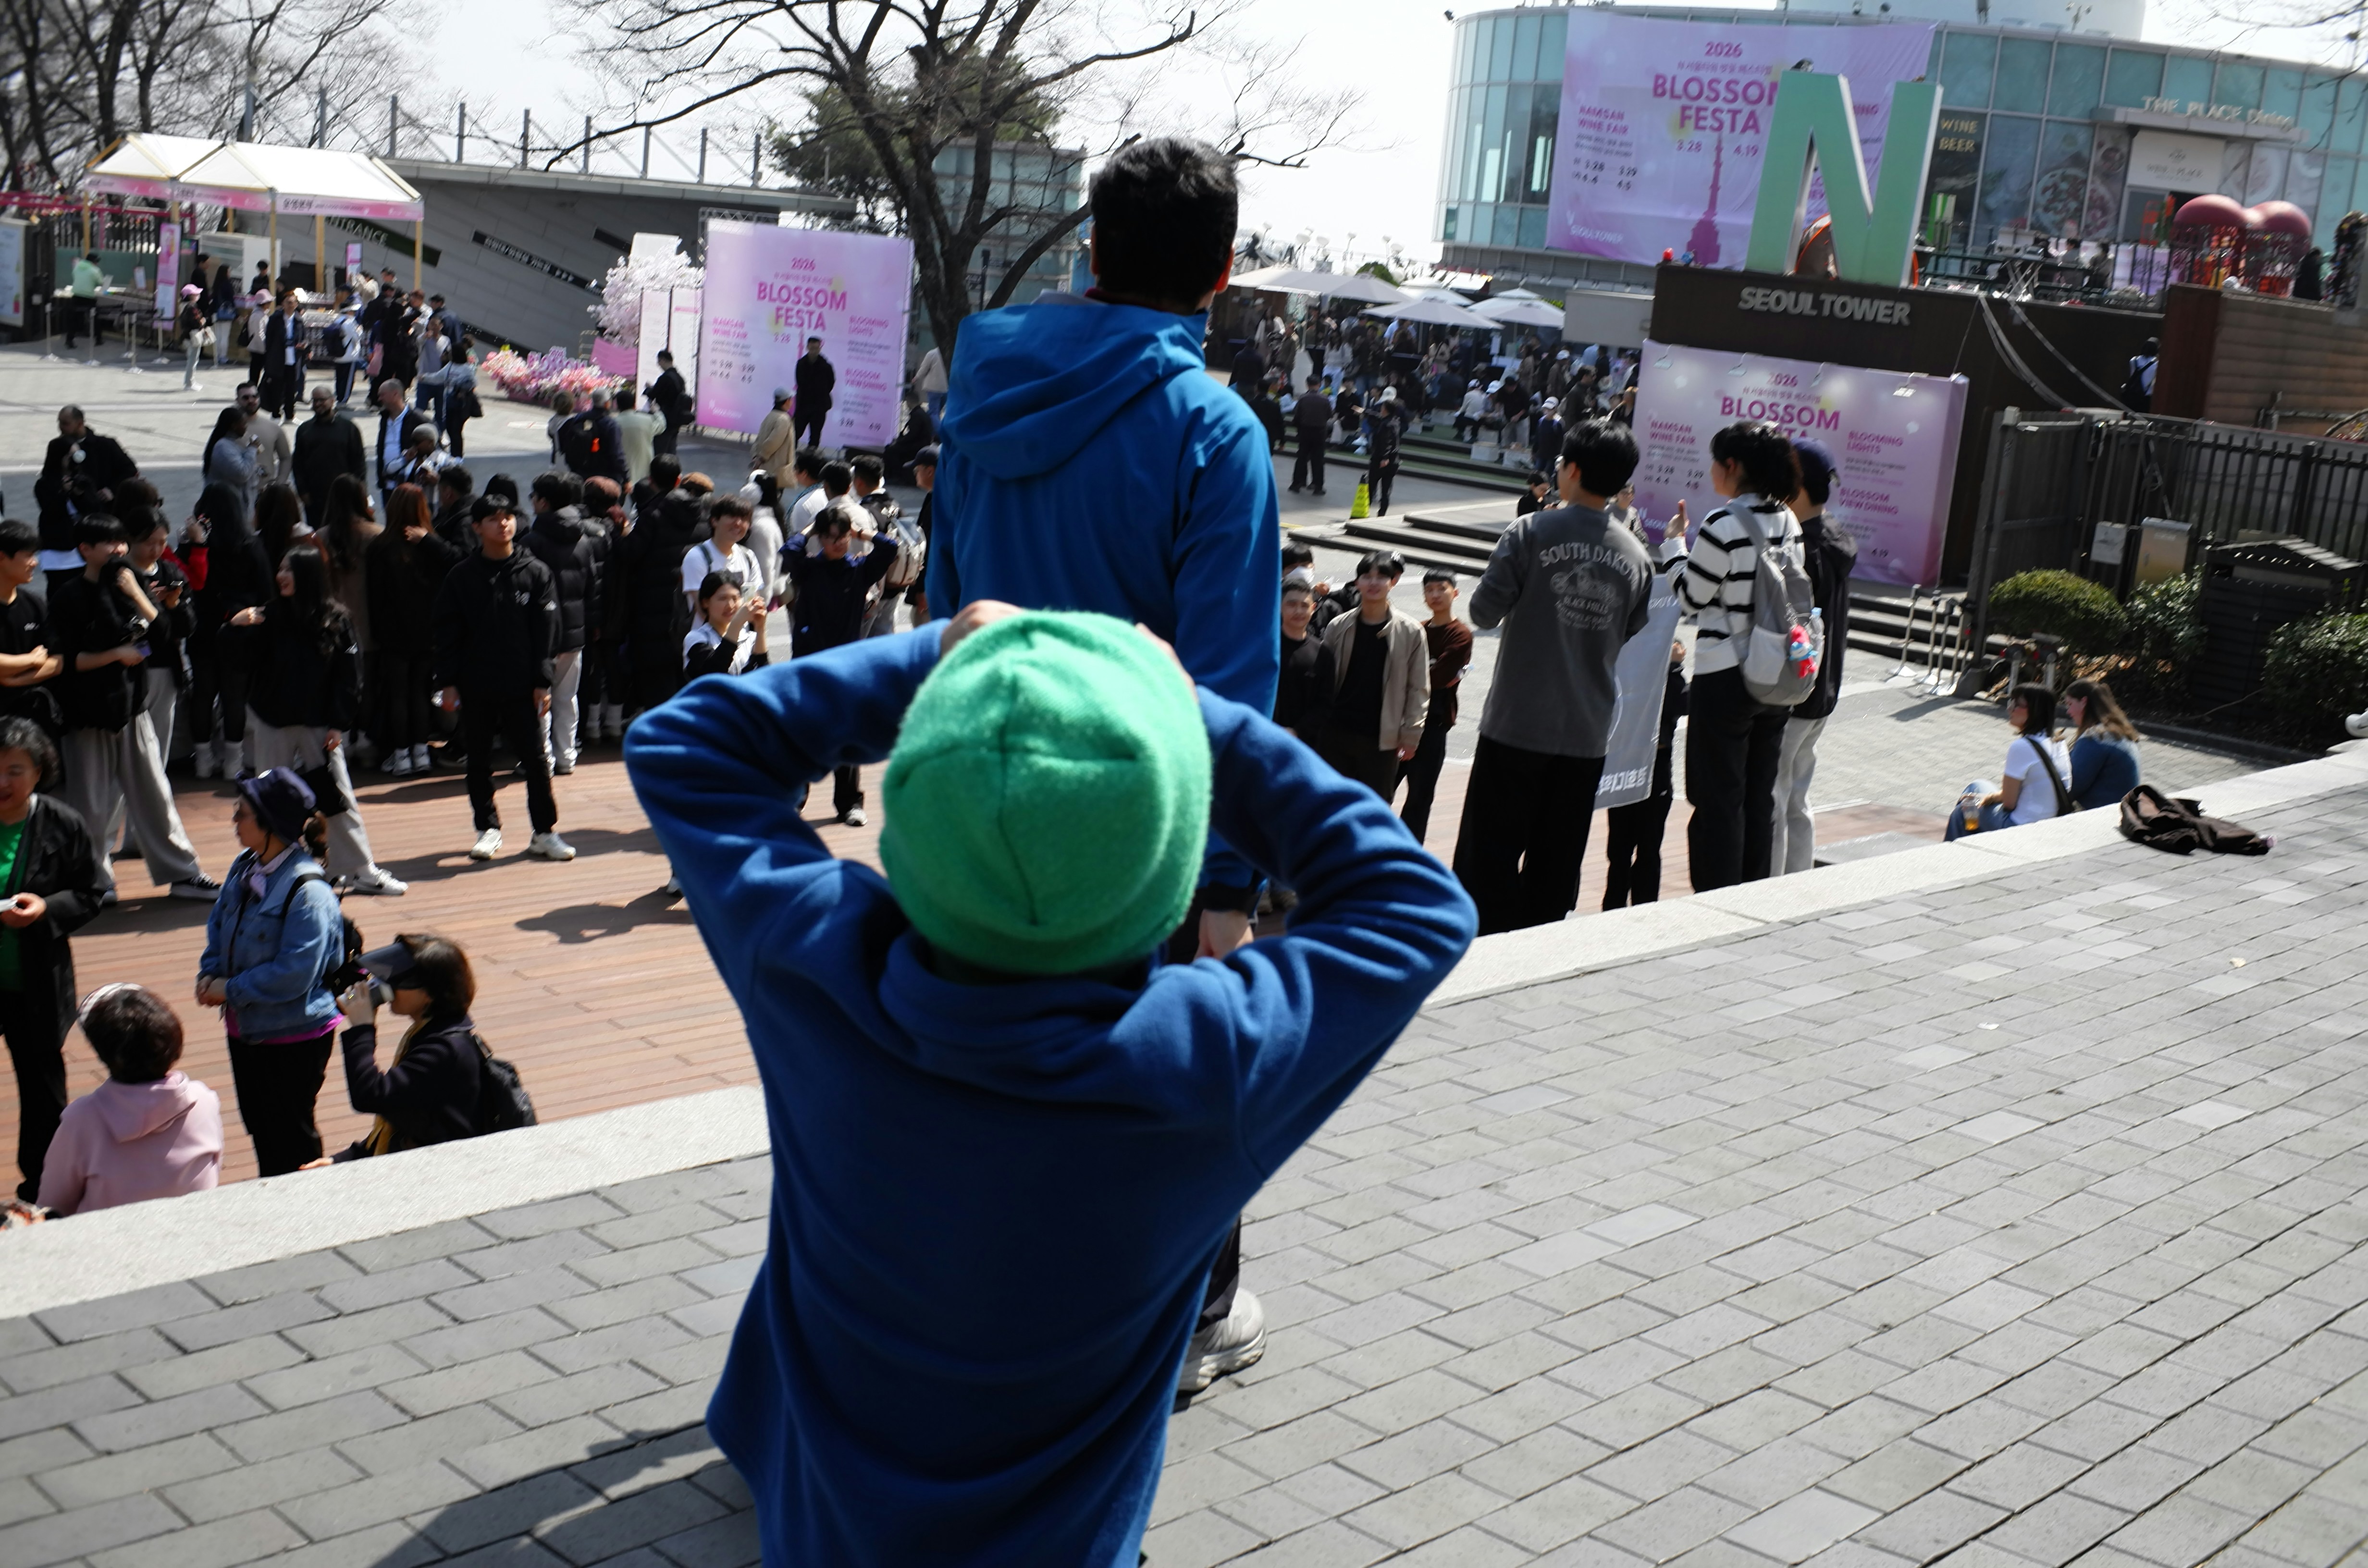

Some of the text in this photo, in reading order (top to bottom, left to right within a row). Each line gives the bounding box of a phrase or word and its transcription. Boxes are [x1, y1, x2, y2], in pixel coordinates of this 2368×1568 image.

[1705, 41, 1743, 58] 2026
[1579, 105, 1625, 121] NAMSAN
[2141, 96, 2180, 113] THE
[2185, 101, 2243, 121] PLACE
[1578, 117, 1629, 136] WINE FAIR
[1679, 104, 1761, 135] FESTA
[1941, 118, 1978, 134] WINE
[1676, 138, 1759, 158] 3.28 4.19
[1939, 137, 1975, 152] BEER
[1585, 159, 1605, 172] 3.28
[1745, 70, 1944, 288] N
[791, 257, 816, 271] 2026
[757, 281, 847, 311] BLOSSOM
[1738, 286, 1911, 326] SEOUL TOWER
[775, 306, 826, 331] FESTA
[1767, 372, 1799, 387] 2026
[1720, 396, 1841, 431] BLOSSOM
[1650, 420, 1692, 434] NAMSAN
[1650, 431, 1696, 445] WINE FAIR
[1848, 430, 1904, 447] BLOOMING
[1847, 441, 1881, 454] LIGHTS
[1839, 487, 1890, 503] BLOSSOM
[1539, 542, 1591, 568] SOUTH
